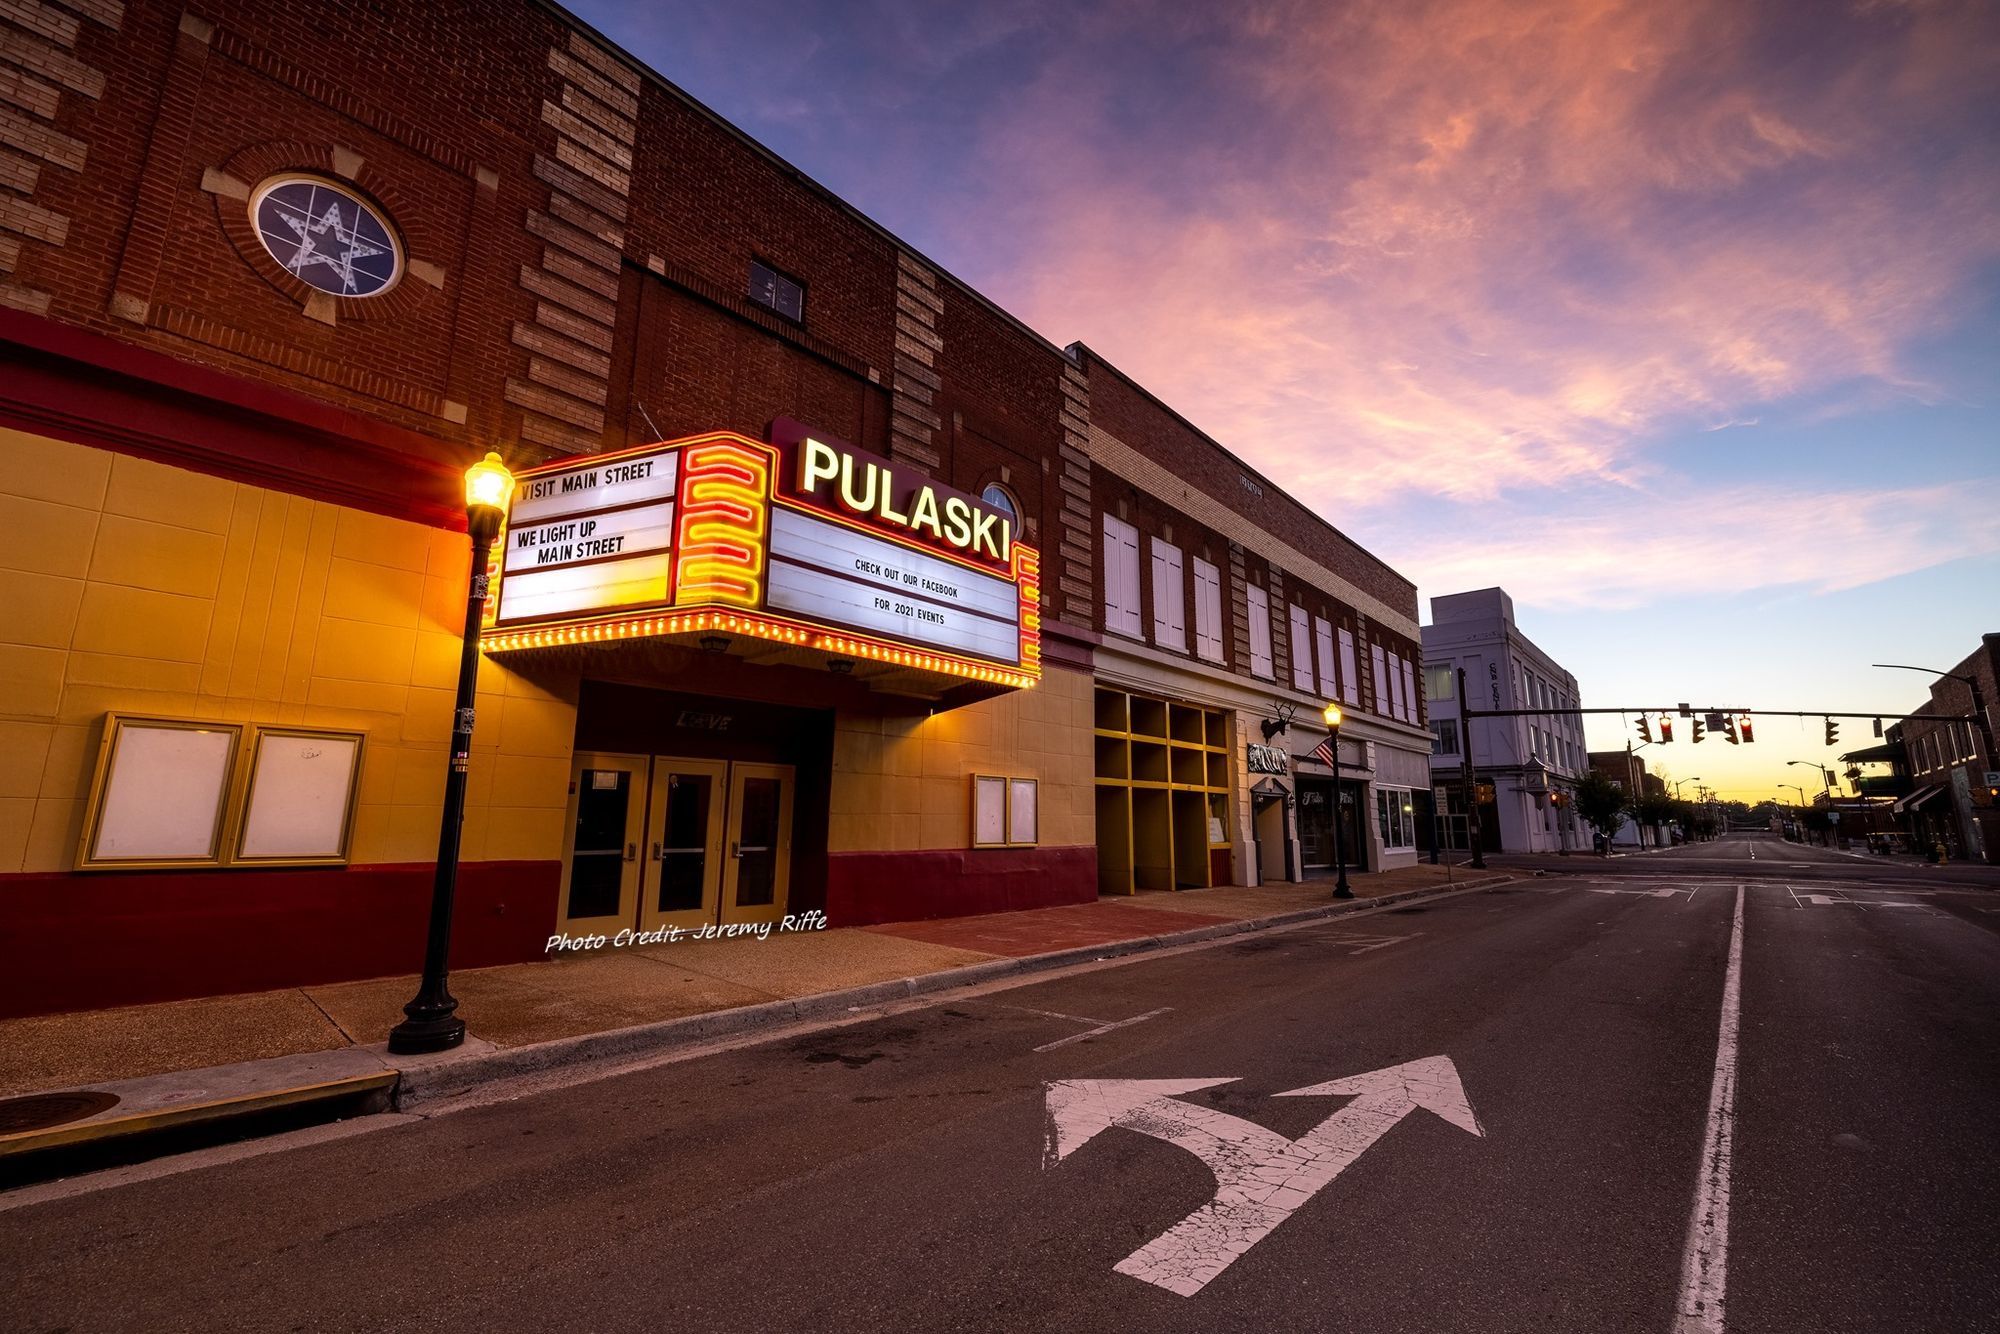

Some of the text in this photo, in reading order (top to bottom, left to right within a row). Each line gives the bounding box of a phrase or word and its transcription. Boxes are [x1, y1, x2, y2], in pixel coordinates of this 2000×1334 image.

[521, 461, 653, 500] VISIT MAIN STREET
[803, 437, 1010, 562] PULASKI
[517, 520, 597, 548] WE LIGHT UP
[537, 536, 625, 564] MAIN STREET
[855, 559, 958, 598] CHECK OUT OUR FACEBOOK
[874, 597, 945, 625] FOR 2021 EVENTS
